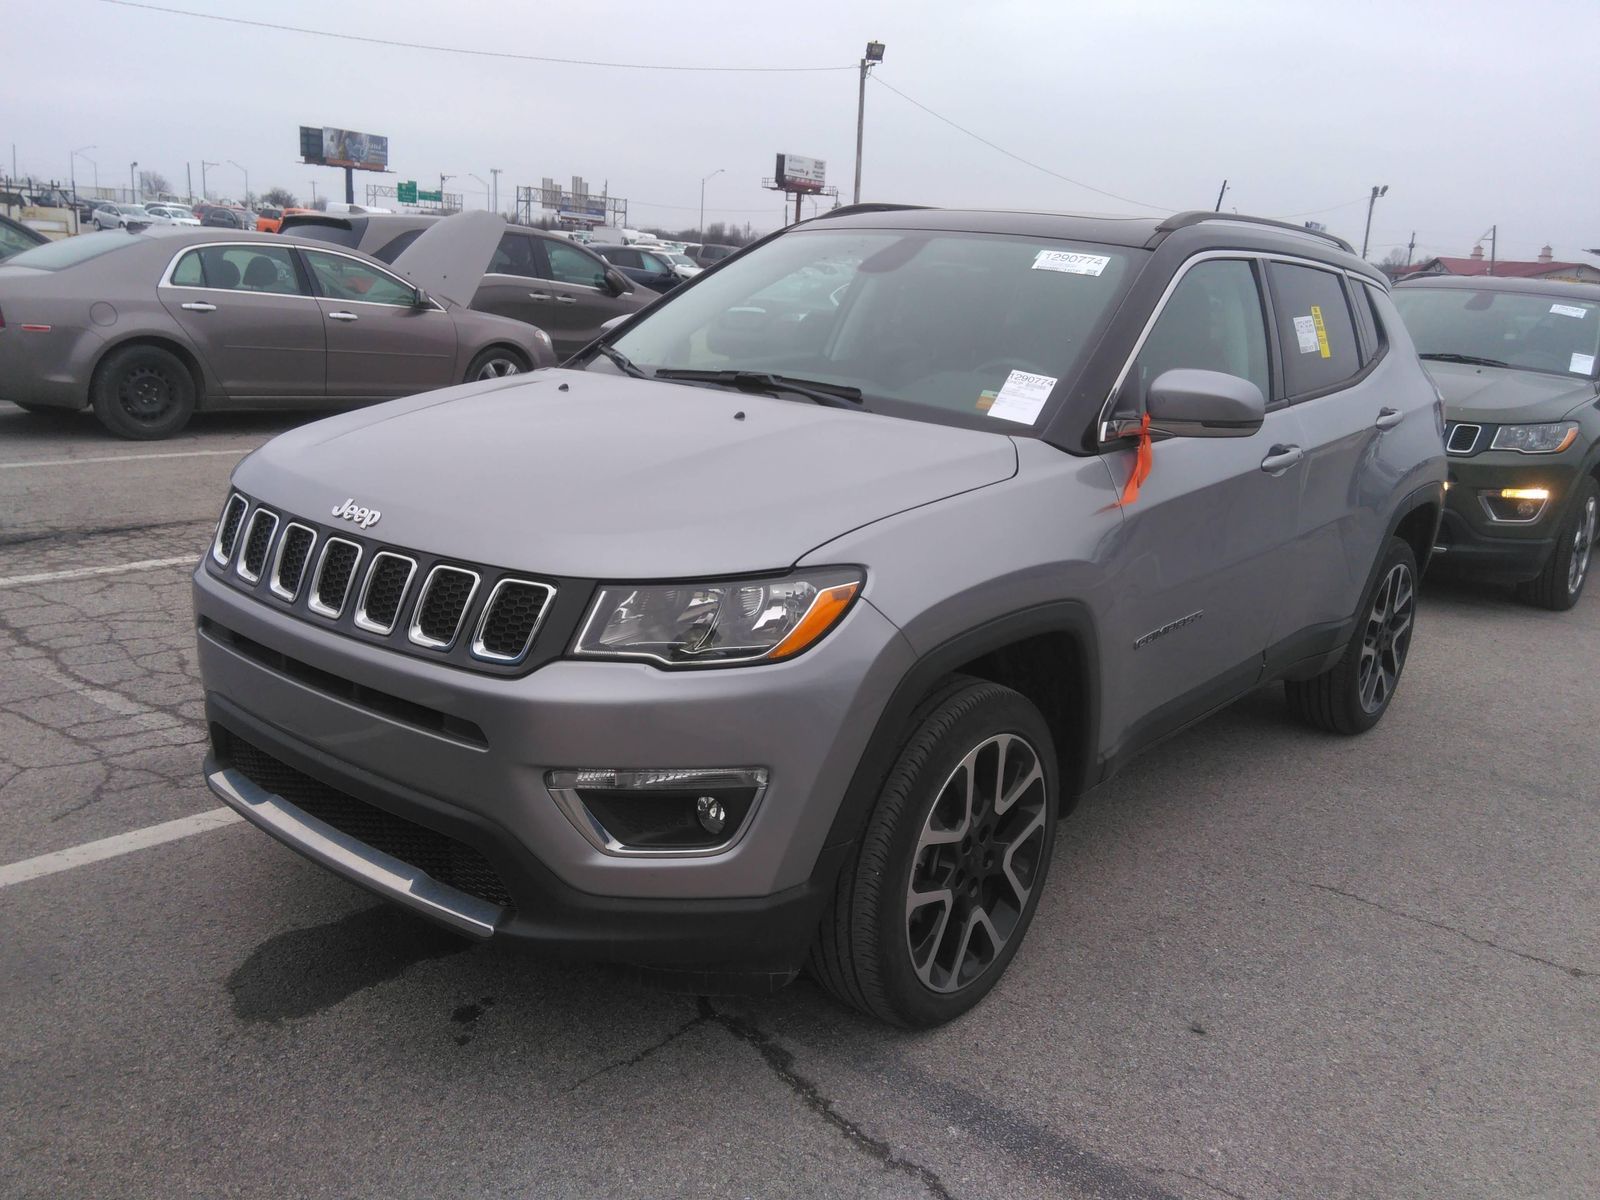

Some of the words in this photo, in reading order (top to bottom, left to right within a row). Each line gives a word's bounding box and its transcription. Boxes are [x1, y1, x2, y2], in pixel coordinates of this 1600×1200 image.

[1046, 253, 1104, 265] 1290774
[1010, 373, 1055, 387] 1290774
[332, 498, 381, 530] Jeep
